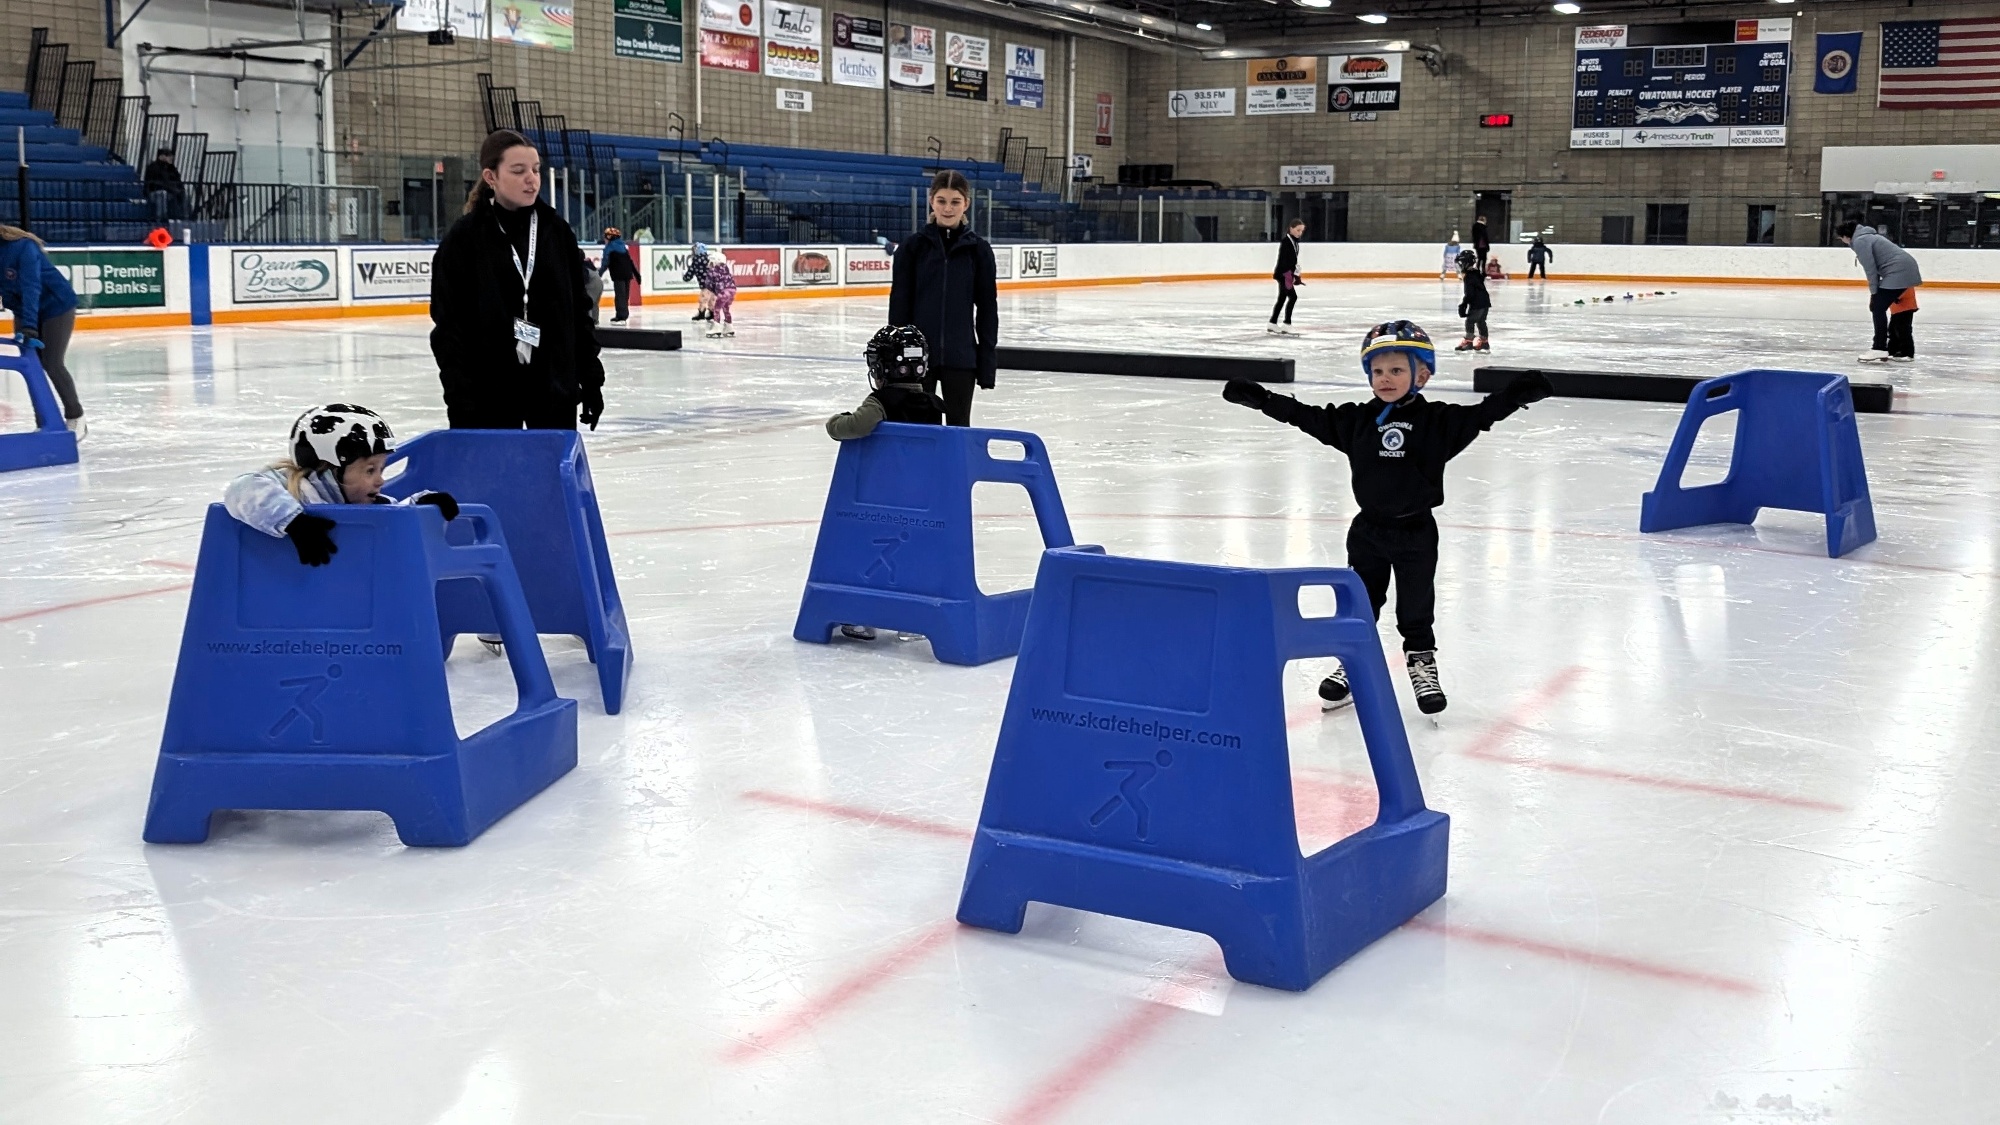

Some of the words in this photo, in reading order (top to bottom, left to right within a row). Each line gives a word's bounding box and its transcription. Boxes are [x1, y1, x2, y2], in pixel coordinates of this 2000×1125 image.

[1580, 29, 1624, 38] FEDERATED
[766, 58, 790, 68] AUTO
[840, 57, 877, 77] dentists
[960, 70, 983, 79] KIBBLE
[1354, 91, 1365, 104] WE
[1365, 90, 1396, 104] DELIVER!
[1639, 91, 1683, 100] OWATONNA
[1685, 90, 1717, 98] HOCKEY
[1200, 101, 1219, 110] KJLY
[1649, 132, 1714, 142] AmesburyTruth
[241, 254, 297, 270] Ocean
[755, 259, 779, 276] TRIP
[850, 261, 890, 271] SCHEELS
[1022, 251, 1042, 274] J&J
[104, 264, 157, 278] Premier
[248, 269, 307, 286] Breeze
[104, 281, 148, 294] Banks
[1378, 422, 1413, 432] OWATONNA
[836, 510, 945, 528] www.skatehelper.com
[207, 640, 403, 658] www.skatehelper.com
[1032, 707, 1241, 749] www.skatehelper.com
